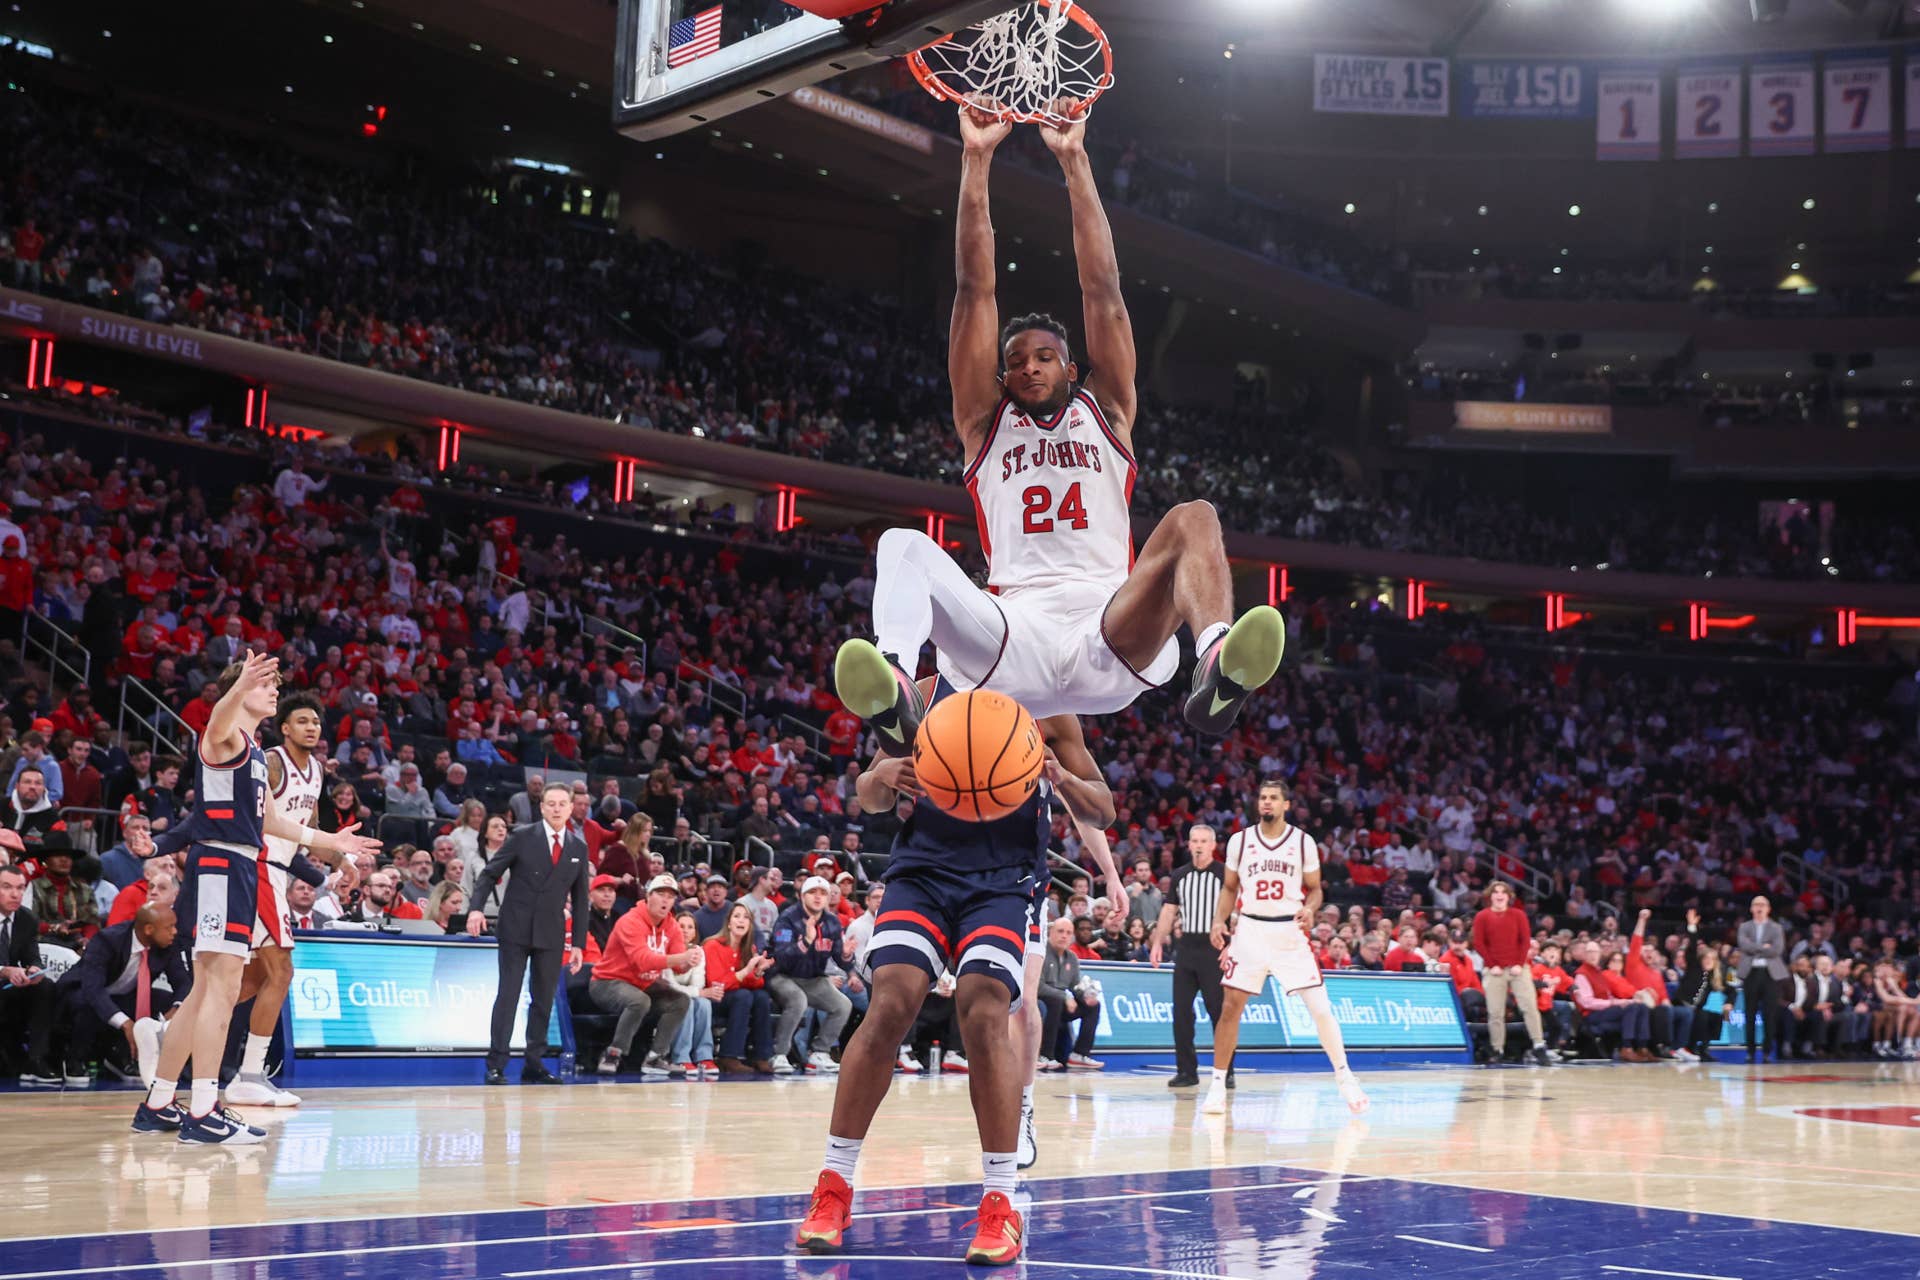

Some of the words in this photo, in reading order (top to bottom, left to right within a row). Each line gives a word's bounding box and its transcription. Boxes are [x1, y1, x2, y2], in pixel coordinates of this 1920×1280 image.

[1320, 78, 1395, 99] STYLES
[1324, 58, 1389, 80] HARRY
[1403, 61, 1443, 100] 15
[1515, 65, 1582, 107] 150
[817, 95, 881, 128] HYUNDAI
[1619, 98, 1638, 138] 1
[1695, 95, 1722, 136] 2
[1769, 92, 1796, 133] 3
[1843, 87, 1870, 129] 7
[80, 316, 139, 345] SUITE
[145, 331, 204, 360] LEVEL
[1002, 444, 1028, 482] ST.
[1031, 438, 1102, 473] JOHN'S
[1022, 482, 1089, 534] 24
[1256, 880, 1284, 900] 23
[348, 980, 432, 1008] Cullen
[1384, 998, 1457, 1031] Dykman
